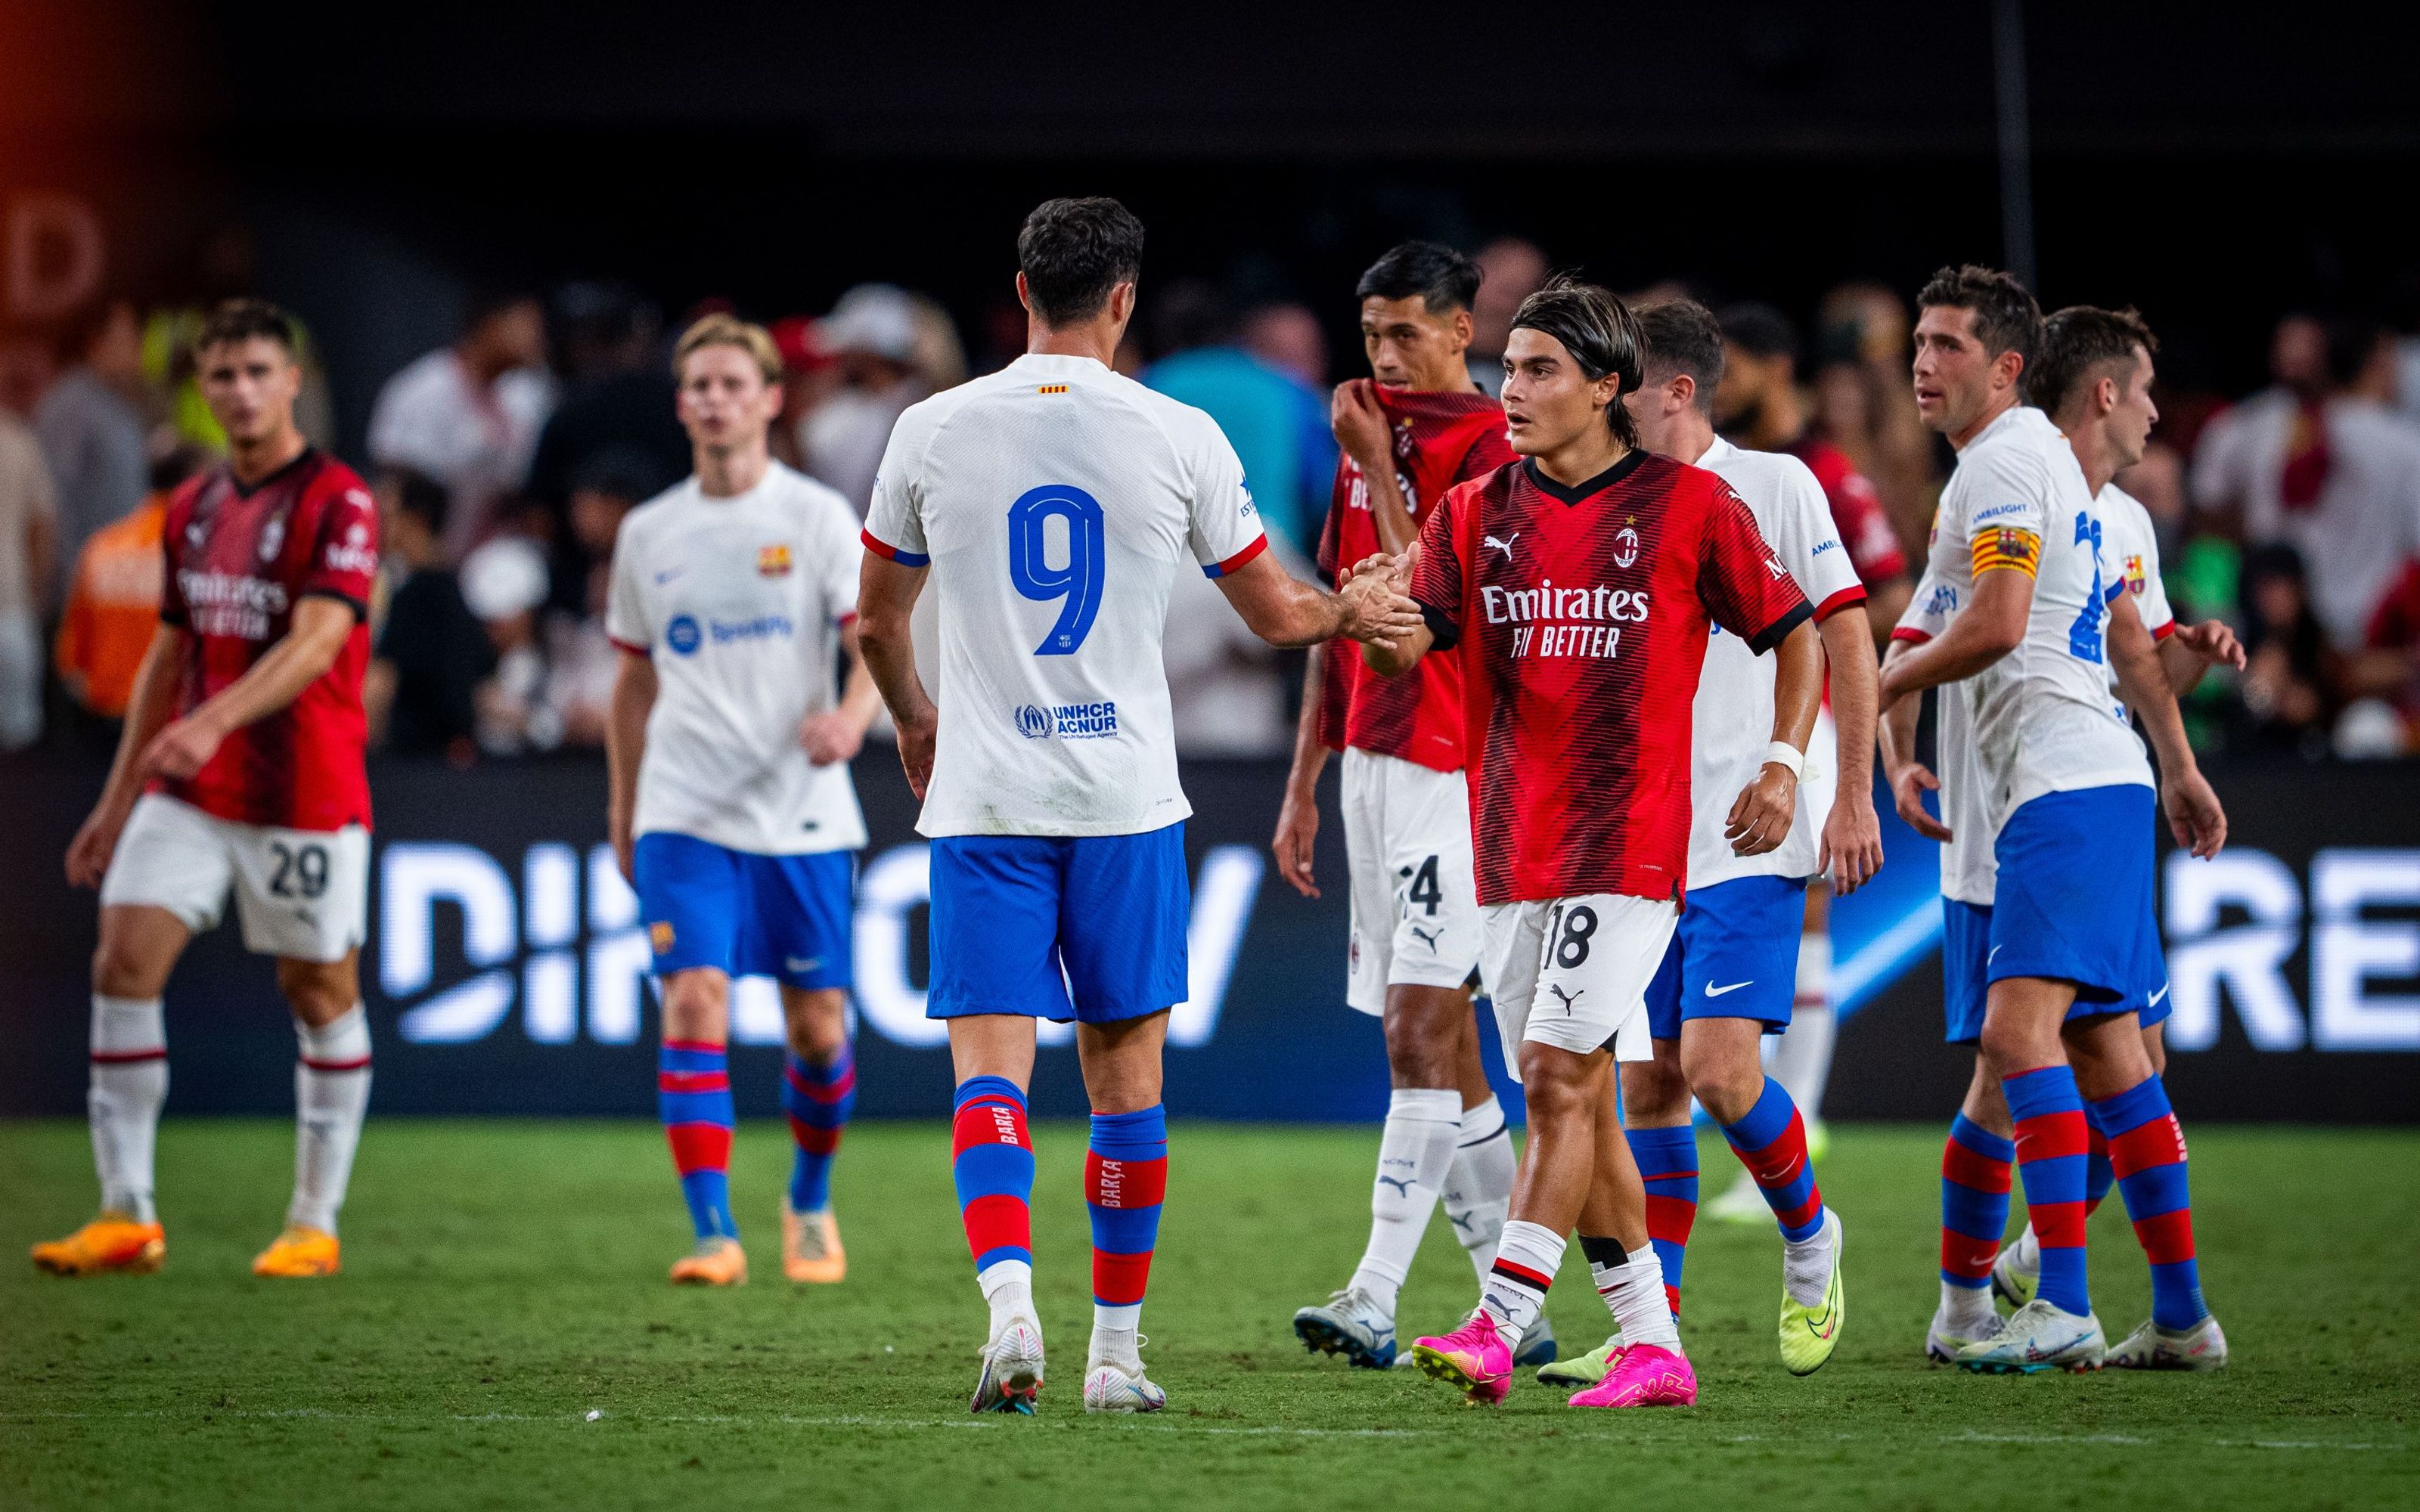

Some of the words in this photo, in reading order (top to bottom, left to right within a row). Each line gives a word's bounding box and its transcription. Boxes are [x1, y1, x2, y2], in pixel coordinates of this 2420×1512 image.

[1007, 484, 1105, 656] 9
[1480, 579, 1649, 623] Emirates
[1540, 626, 1620, 658] BETTER
[1053, 702, 1115, 719] UNHCR
[1057, 716, 1117, 733] ACNUR
[270, 842, 328, 898] 29
[1544, 905, 1598, 969] 18
[1100, 1160, 1125, 1207] BARÇA
